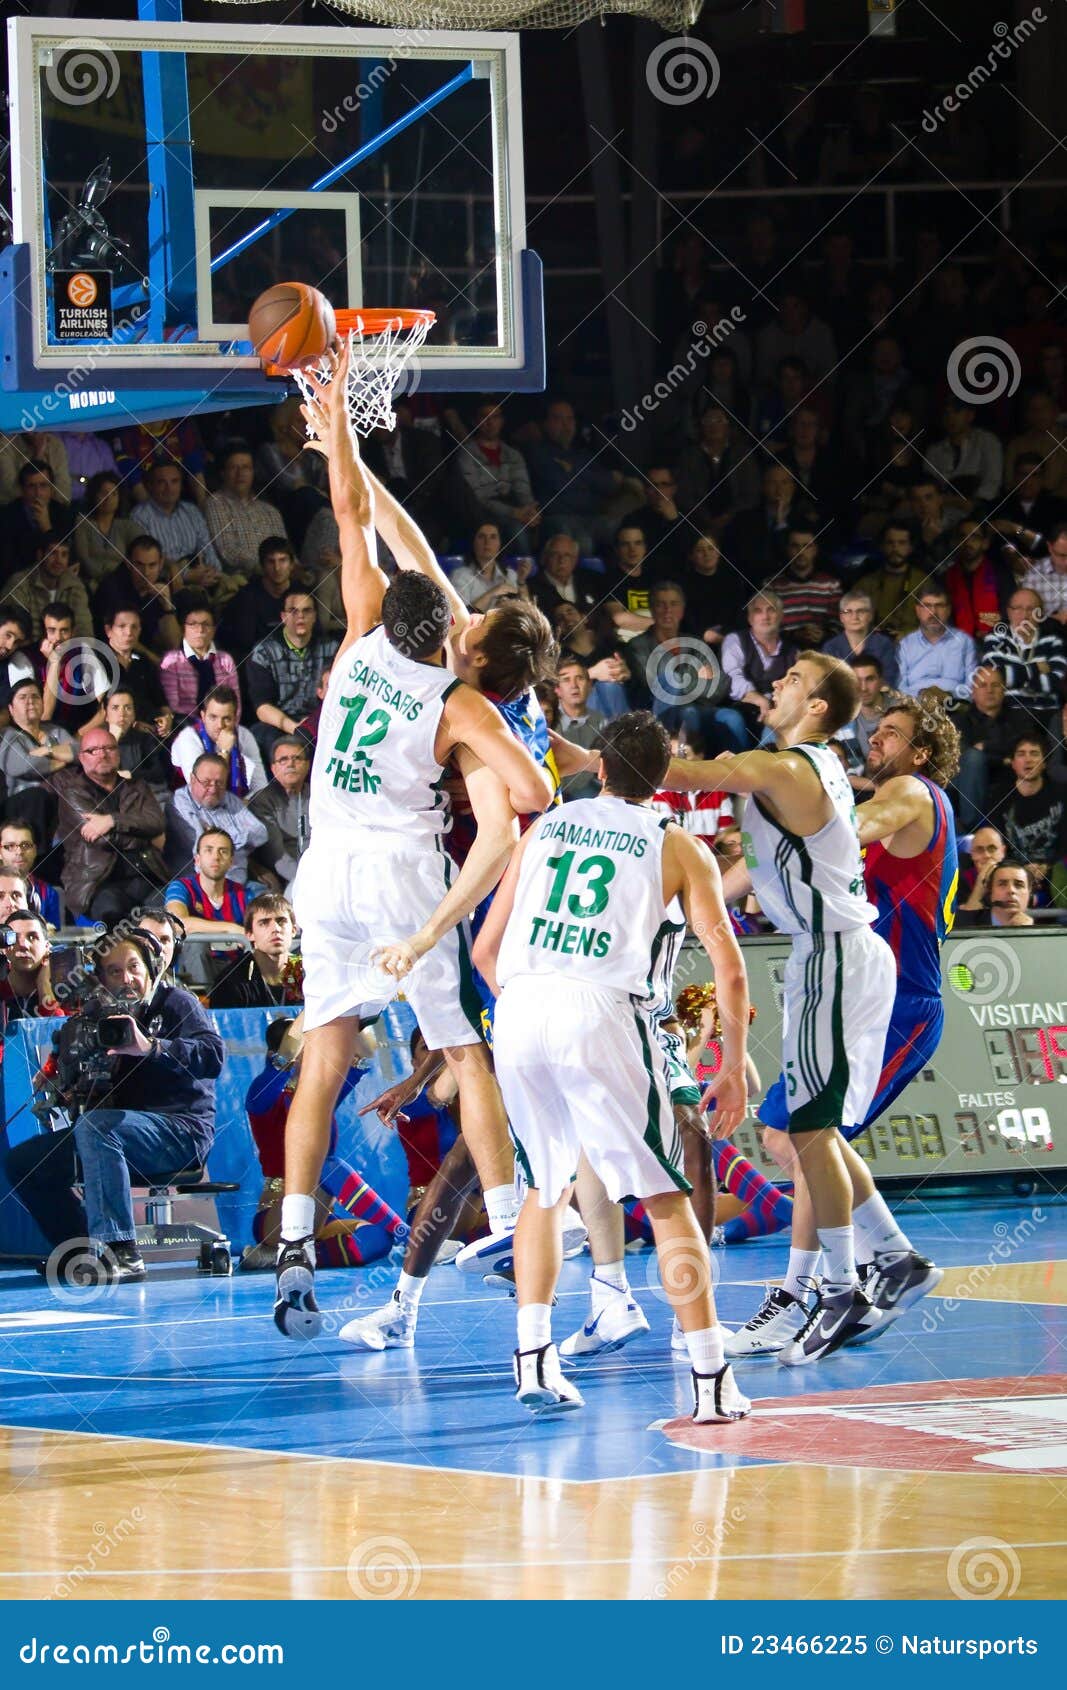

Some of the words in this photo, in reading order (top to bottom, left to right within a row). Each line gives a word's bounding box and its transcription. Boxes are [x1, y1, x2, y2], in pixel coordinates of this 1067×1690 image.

[59, 308, 108, 319] TURKISH
[59, 319, 108, 329] AIRLINES
[334, 692, 392, 768] 12
[540, 820, 648, 858] DIAMANTIDIS
[545, 850, 617, 919] 13
[528, 916, 612, 958] THENS
[958, 1092, 1017, 1109] FALTES
